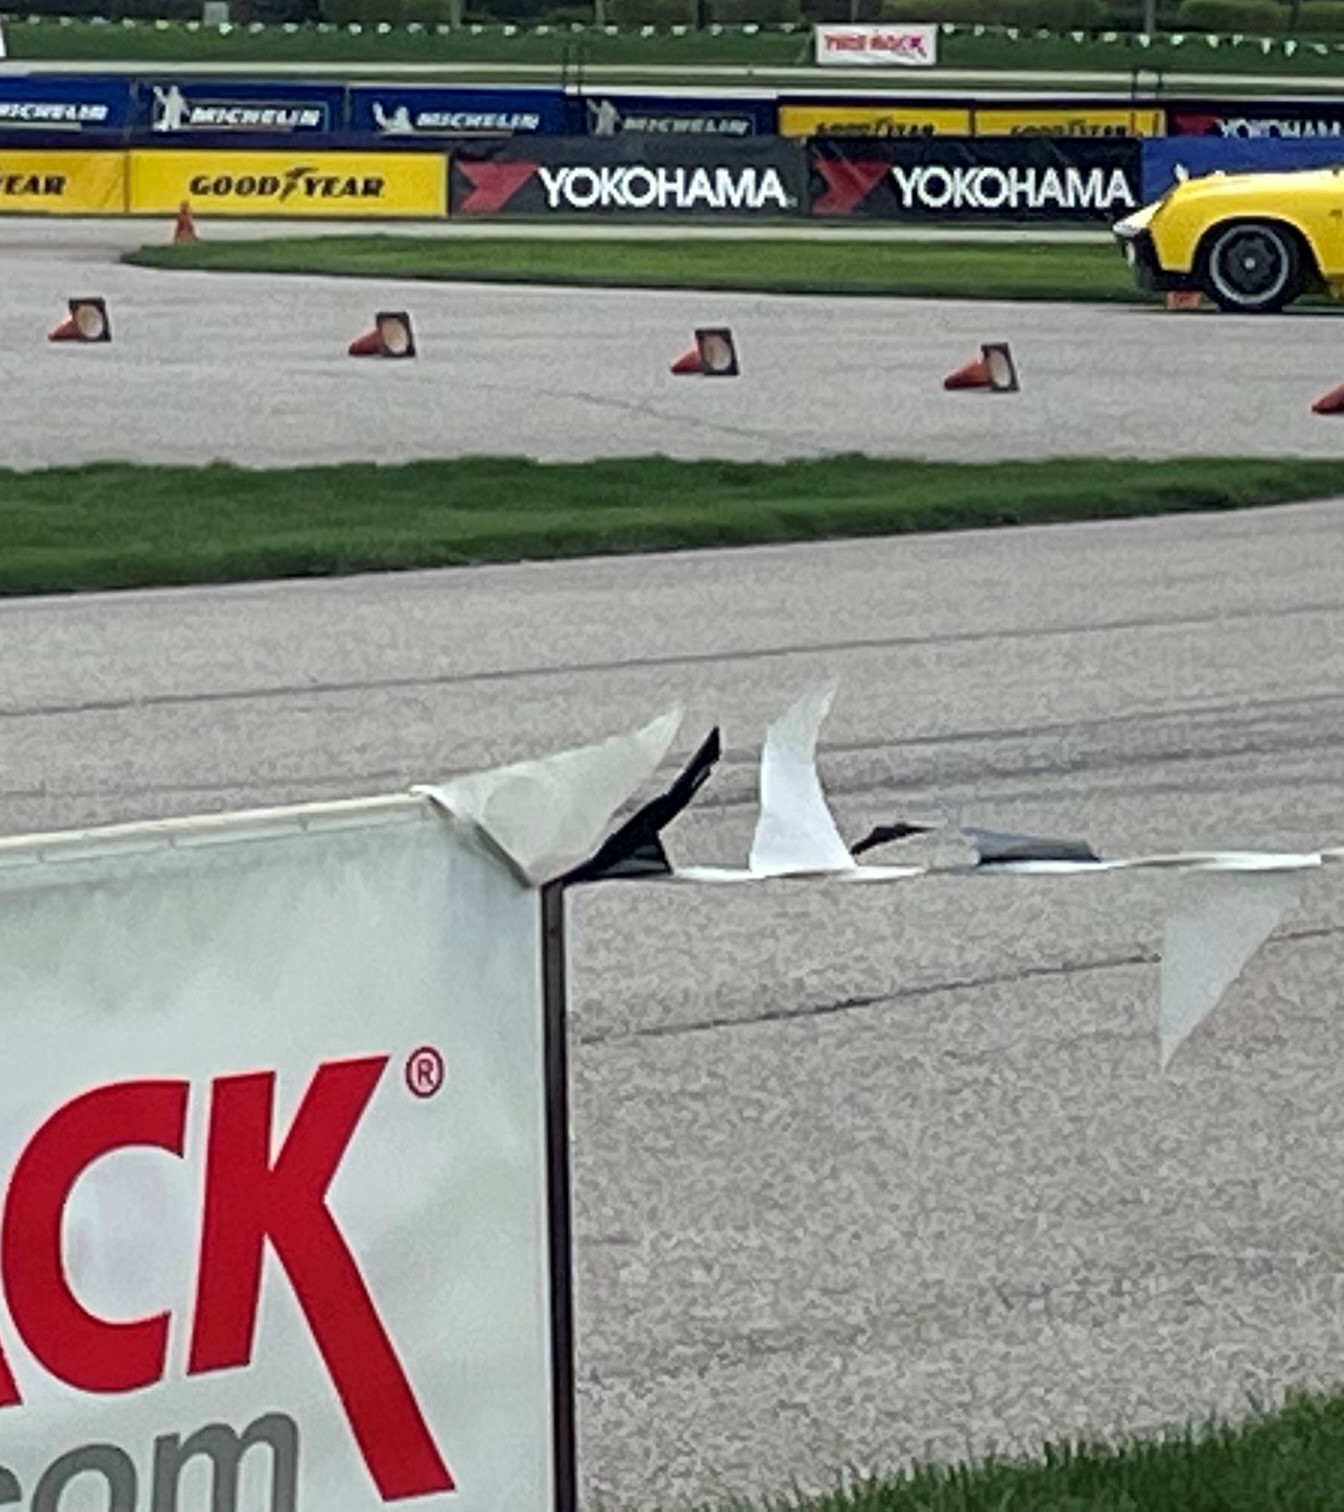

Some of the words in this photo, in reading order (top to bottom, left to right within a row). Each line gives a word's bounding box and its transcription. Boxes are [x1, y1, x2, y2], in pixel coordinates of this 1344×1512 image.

[189, 105, 322, 128] MICHELIN
[416, 110, 541, 131] MICHELIN
[538, 165, 788, 209] YOKOHAMA
[891, 166, 1136, 209] YOKOHAMA
